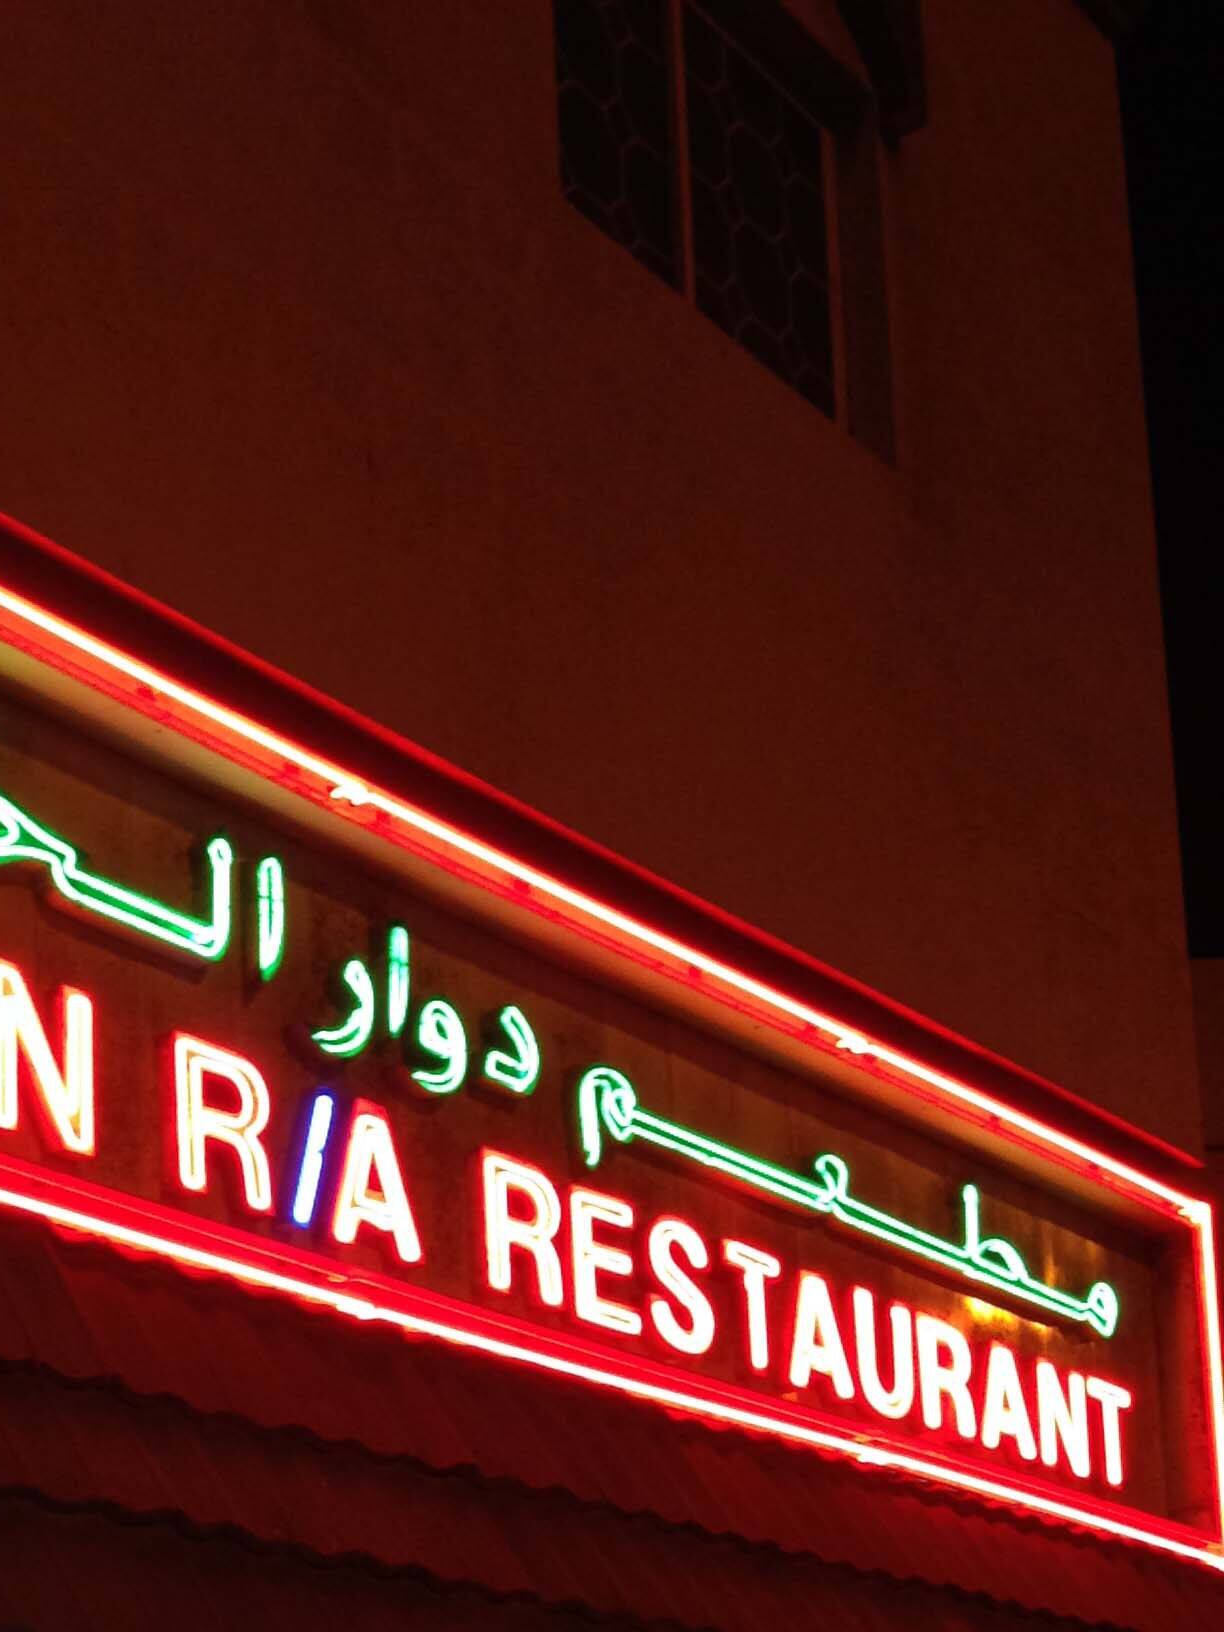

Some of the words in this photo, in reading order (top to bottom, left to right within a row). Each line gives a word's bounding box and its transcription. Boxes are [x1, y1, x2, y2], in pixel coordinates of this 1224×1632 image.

[311, 925, 541, 1094] دوار
[482, 1147, 1132, 1487] RESTAURANT
[578, 1067, 1119, 1338] مطعم
